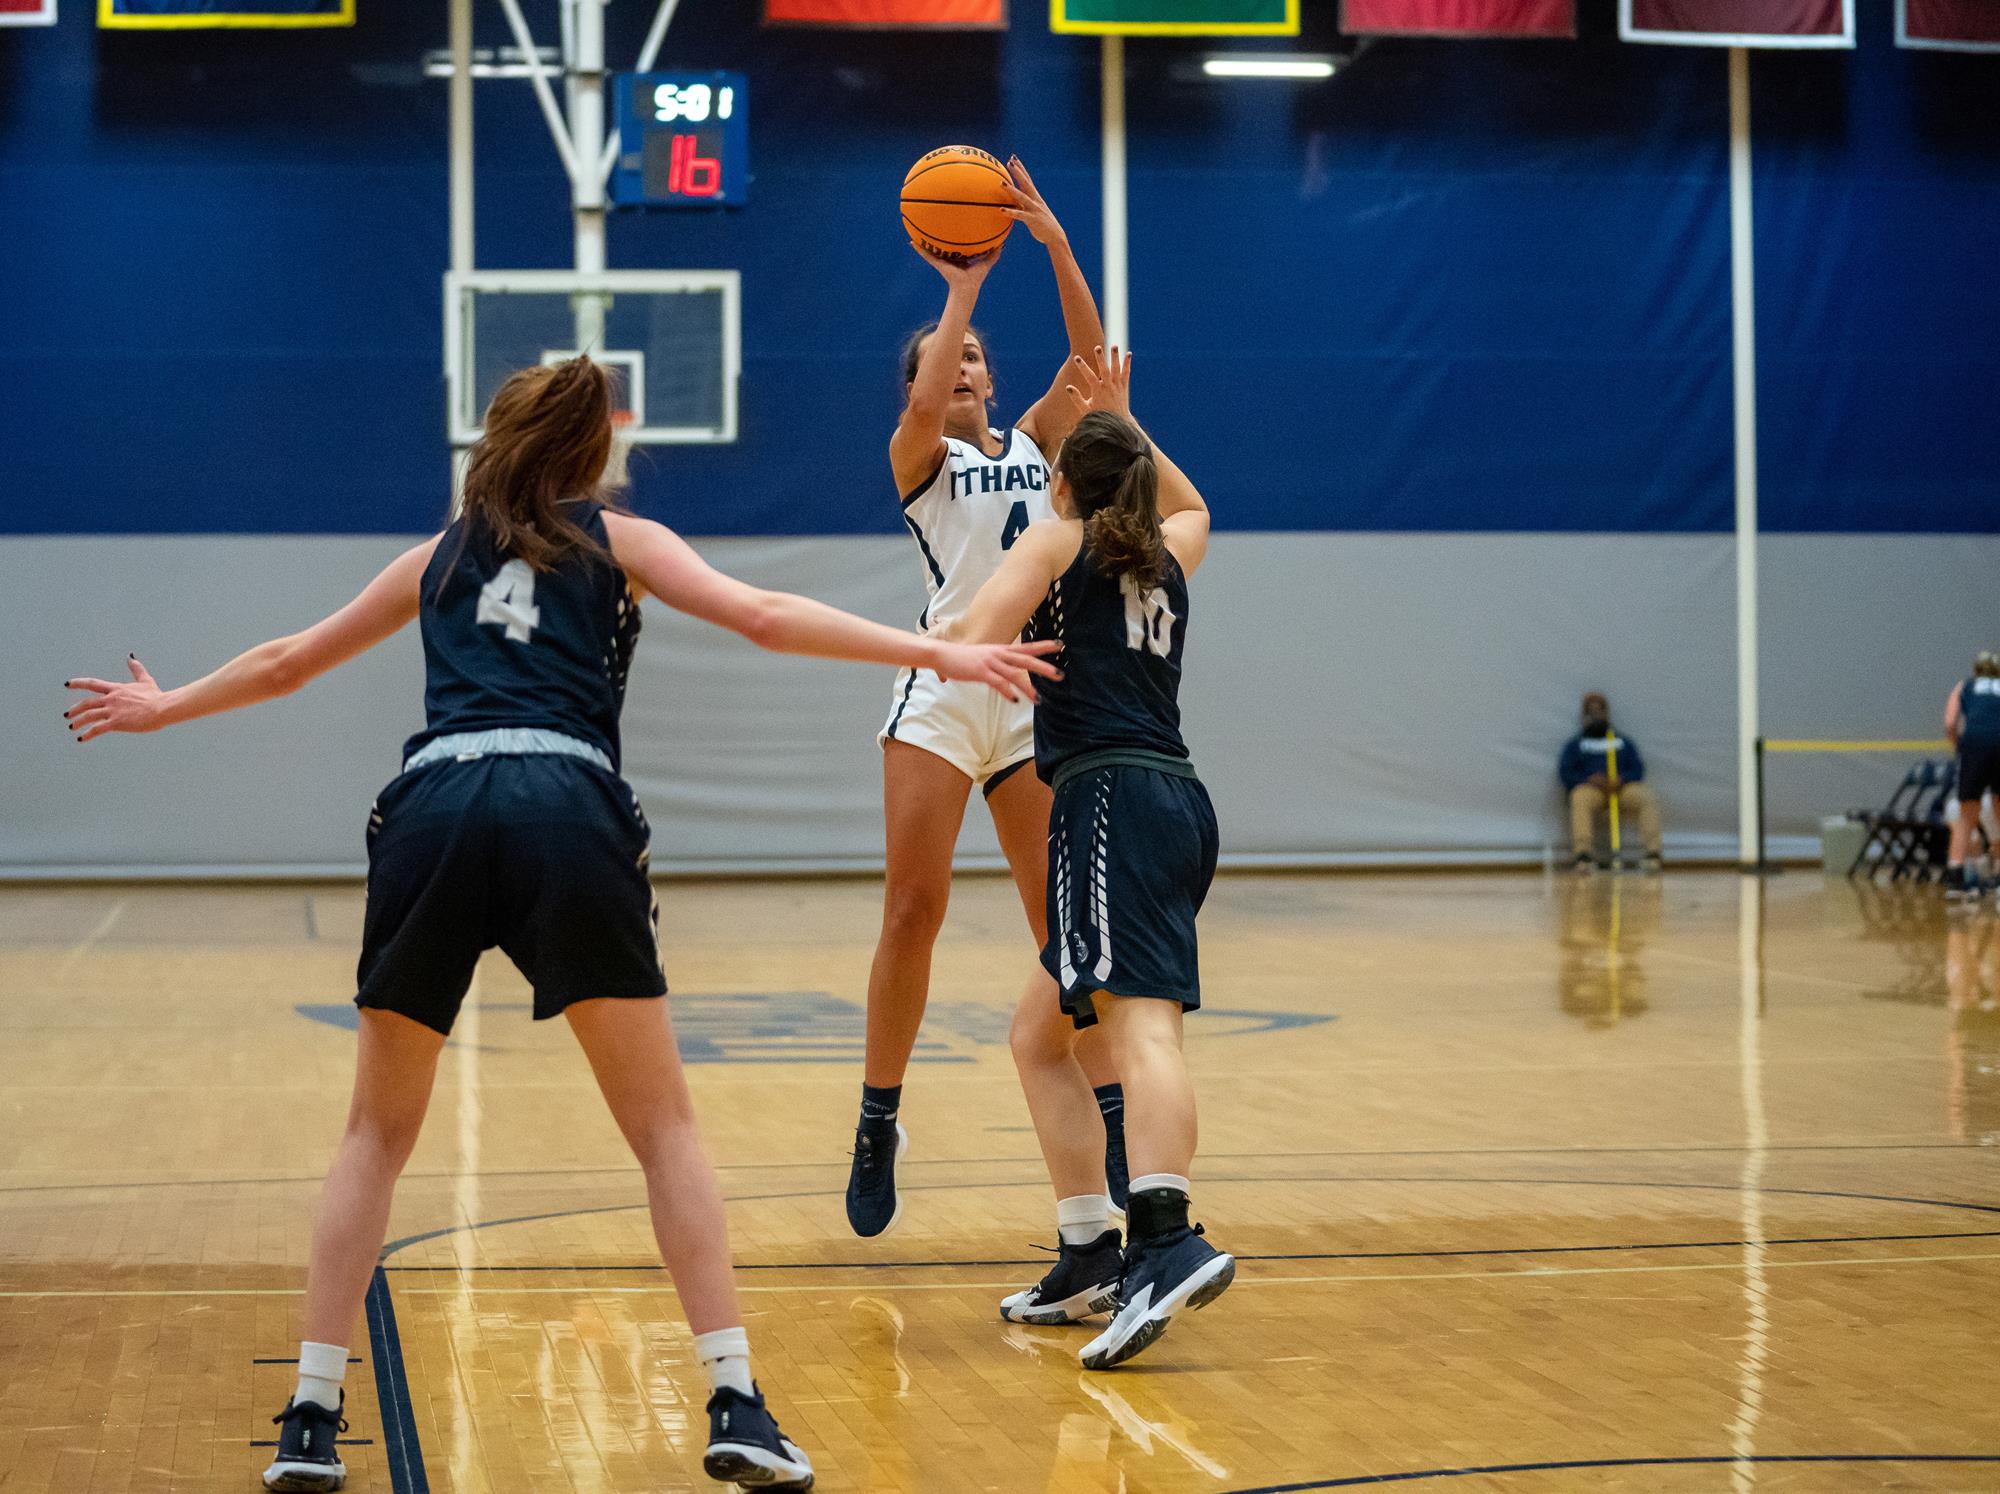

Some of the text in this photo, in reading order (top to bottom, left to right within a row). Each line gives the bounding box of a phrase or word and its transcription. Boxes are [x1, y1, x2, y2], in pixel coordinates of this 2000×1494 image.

[654, 83, 734, 122] 5:01
[668, 134, 721, 197] 16
[476, 558, 541, 644] 4
[1119, 571, 1177, 659] 10
